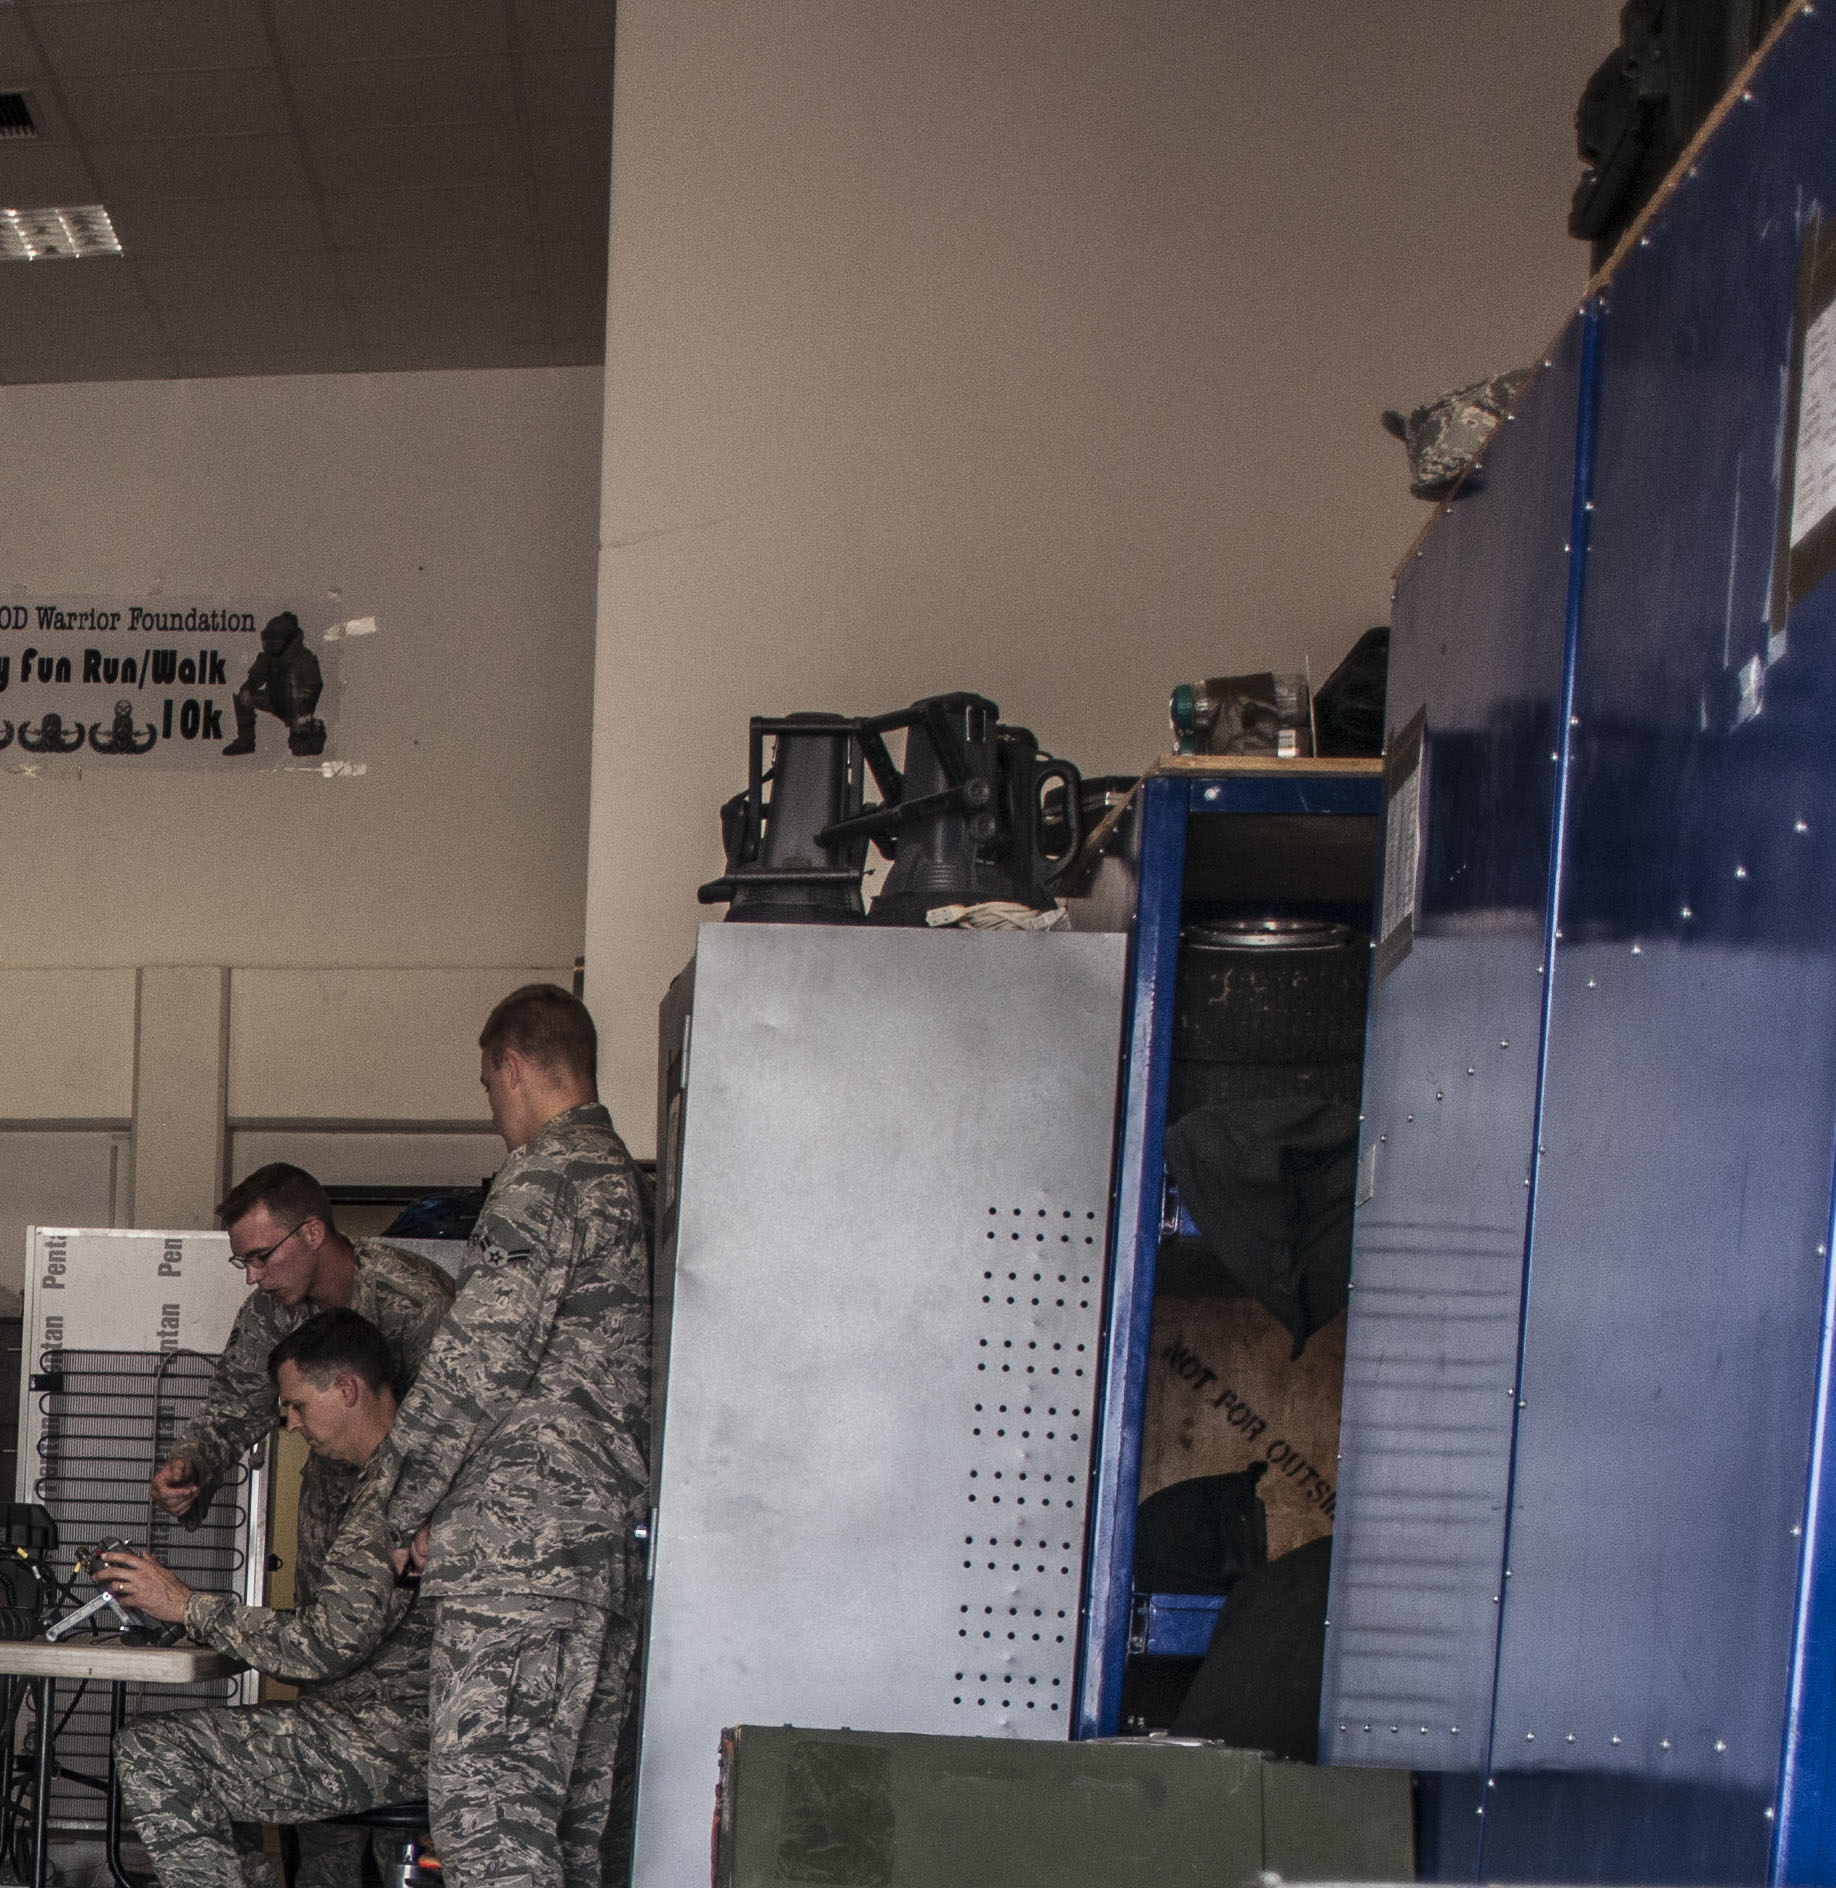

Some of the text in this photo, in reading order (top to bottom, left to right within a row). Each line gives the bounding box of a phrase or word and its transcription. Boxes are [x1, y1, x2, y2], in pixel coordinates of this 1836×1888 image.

[35, 606, 121, 632] Warrior
[127, 607, 257, 633] Foundation
[83, 648, 227, 690] Run/Walk
[160, 698, 224, 741] 10k
[1160, 1341, 1217, 1390] NOT
[1213, 1389, 1267, 1442] FOR
